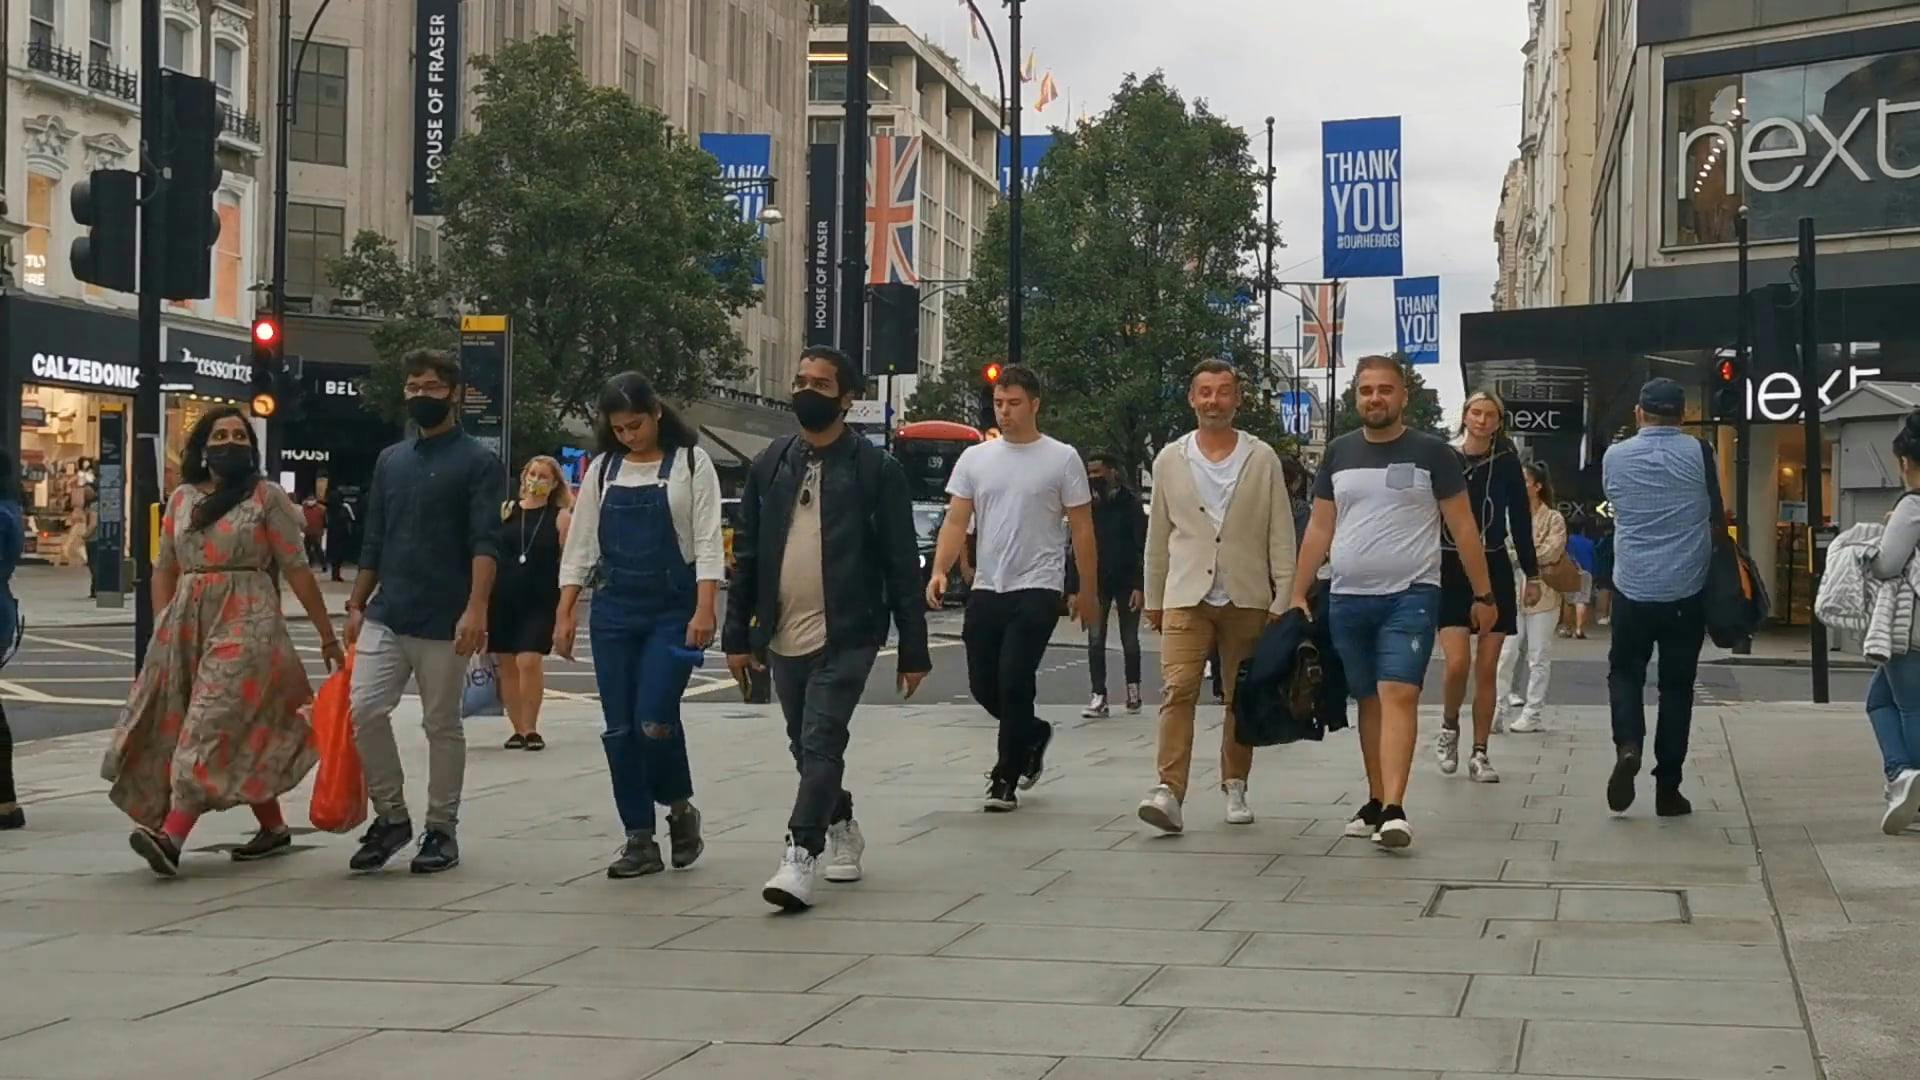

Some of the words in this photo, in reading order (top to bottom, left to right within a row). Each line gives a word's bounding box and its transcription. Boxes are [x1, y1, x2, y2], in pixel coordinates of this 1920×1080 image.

[428, 14, 446, 82] FRASER
[428, 88, 444, 114] OF
[1325, 148, 1399, 184] THANK
[1677, 97, 1920, 200] next
[1330, 181, 1400, 233] YOU
[816, 220, 828, 264] FRASER
[816, 267, 827, 284] OF
[815, 286, 827, 328] HOUSE
[1396, 293, 1438, 315] THANK
[1400, 313, 1438, 344] YOU
[1505, 409, 1561, 429] next
